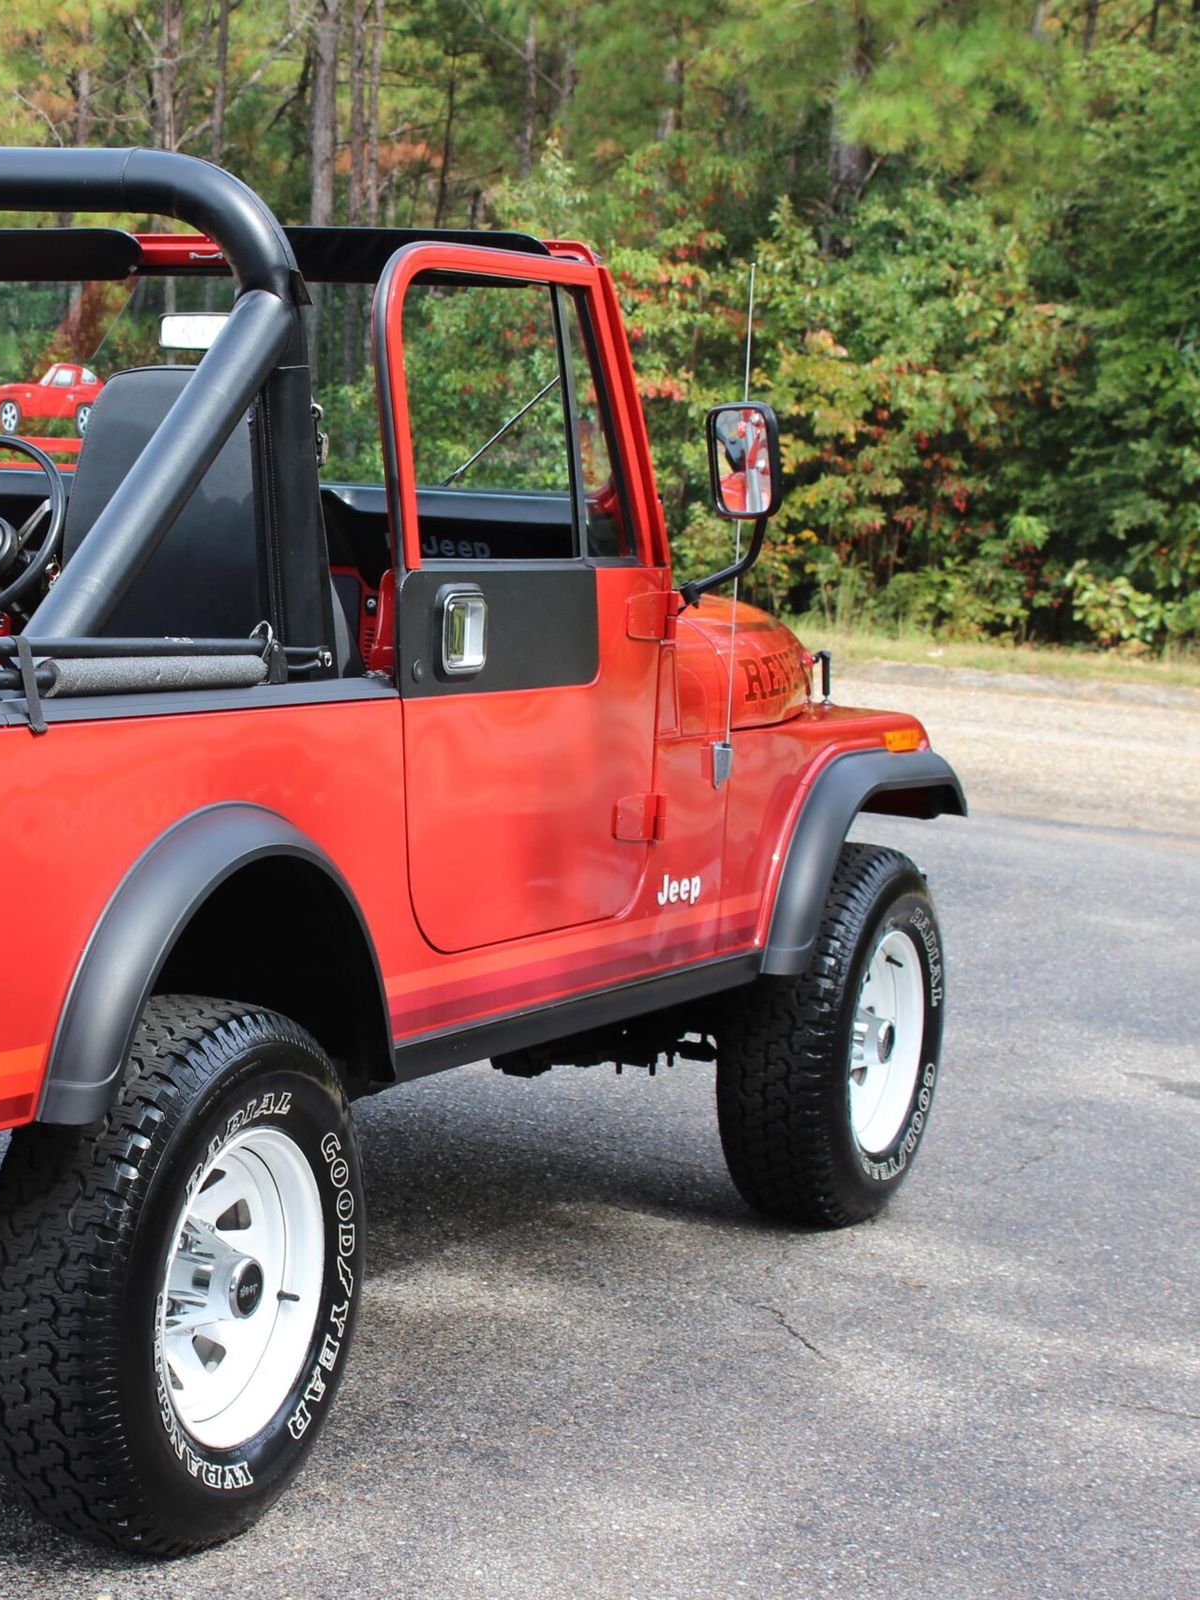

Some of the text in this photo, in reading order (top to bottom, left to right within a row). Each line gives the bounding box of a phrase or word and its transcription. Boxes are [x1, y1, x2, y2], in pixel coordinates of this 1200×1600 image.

[422, 535, 491, 559] Jeep
[657, 873, 701, 906] Jeep
[908, 907, 942, 1007] RADIAL
[287, 1132, 355, 1440] GOODYEAR
